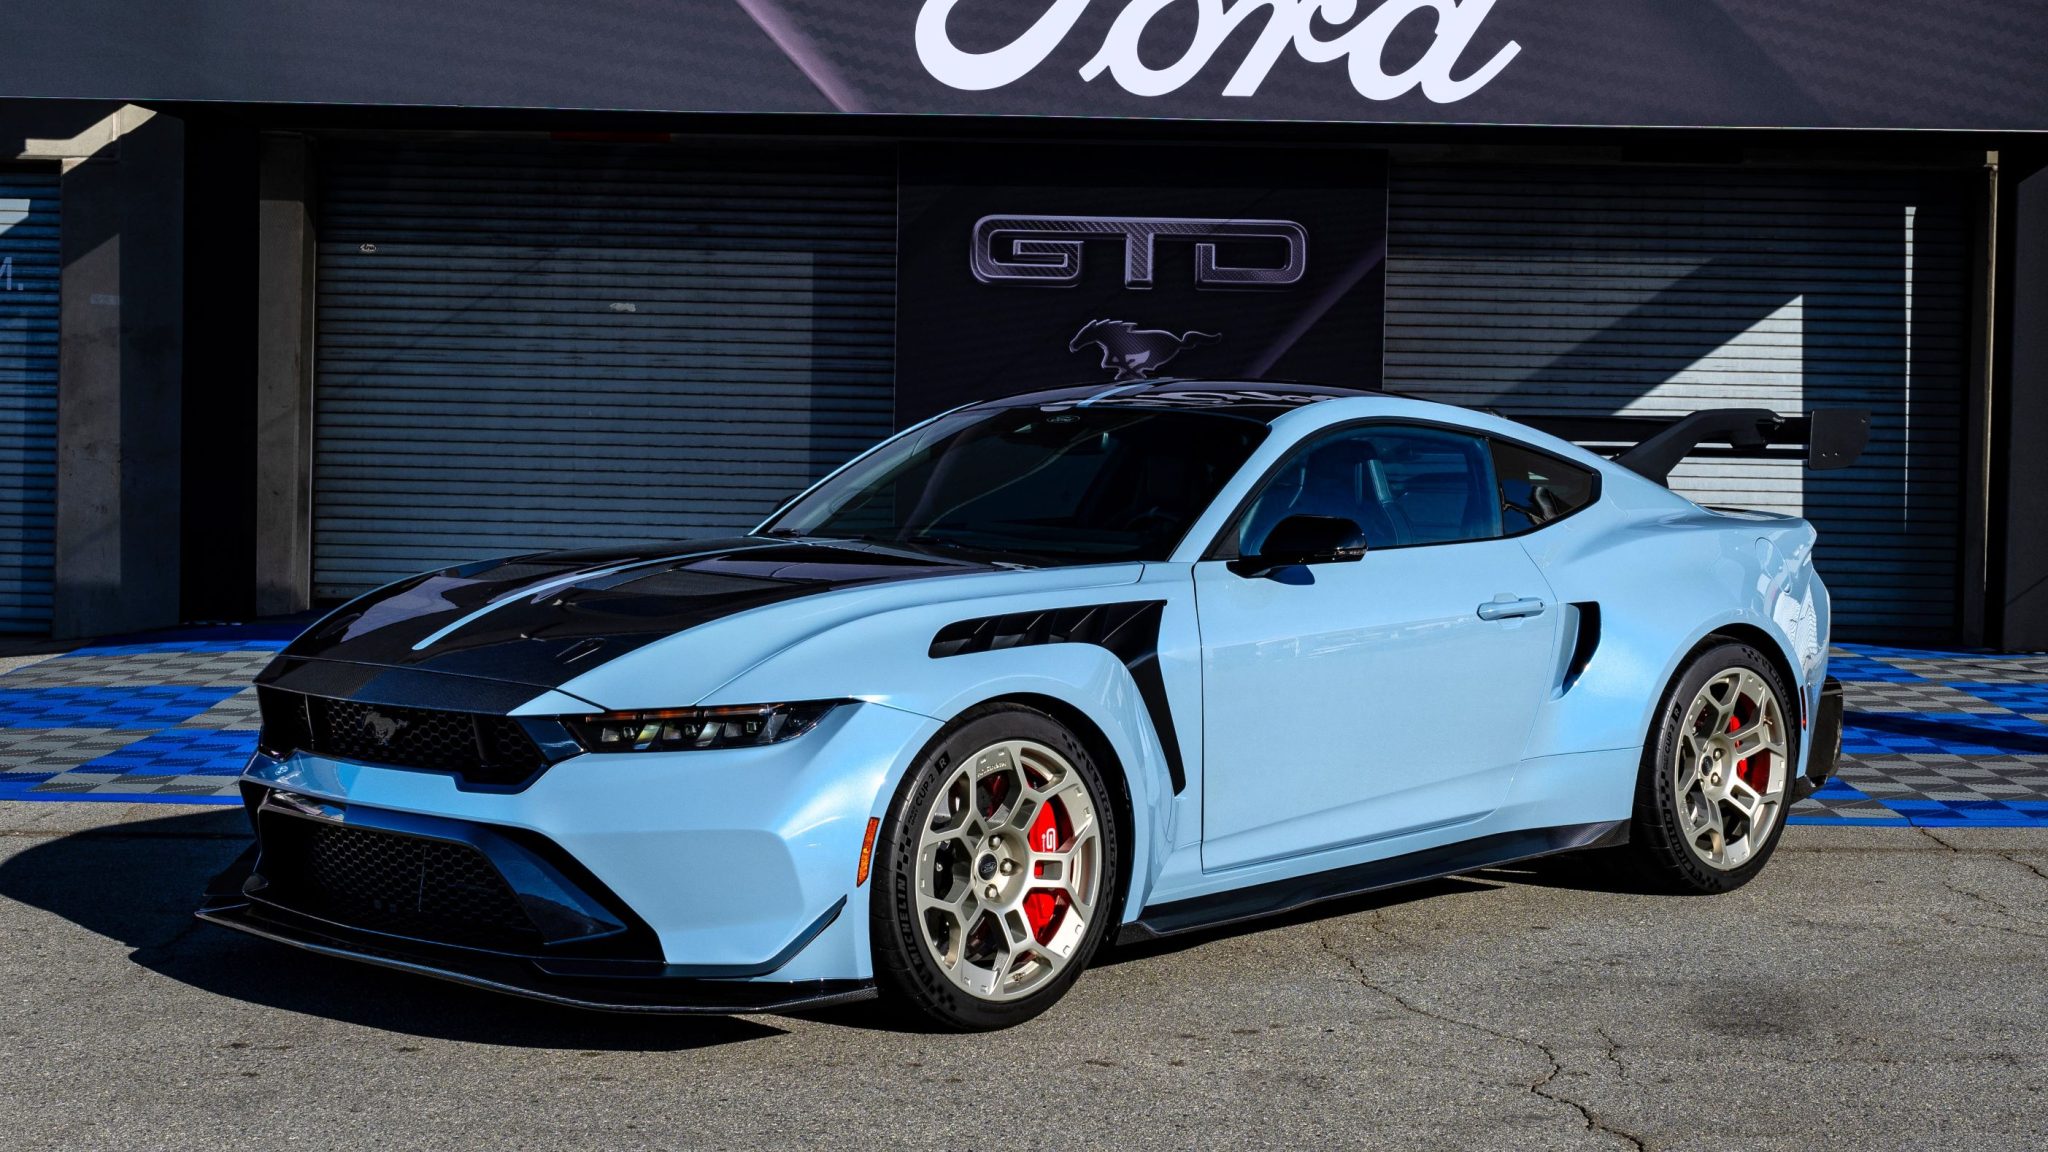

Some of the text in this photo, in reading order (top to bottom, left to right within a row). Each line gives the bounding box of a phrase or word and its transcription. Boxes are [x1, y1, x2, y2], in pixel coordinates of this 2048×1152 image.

[970, 213, 1310, 290] GTD
[916, 781, 929, 806] CUP
[929, 773, 935, 783] 2
[897, 878, 923, 967] MICHELIN
